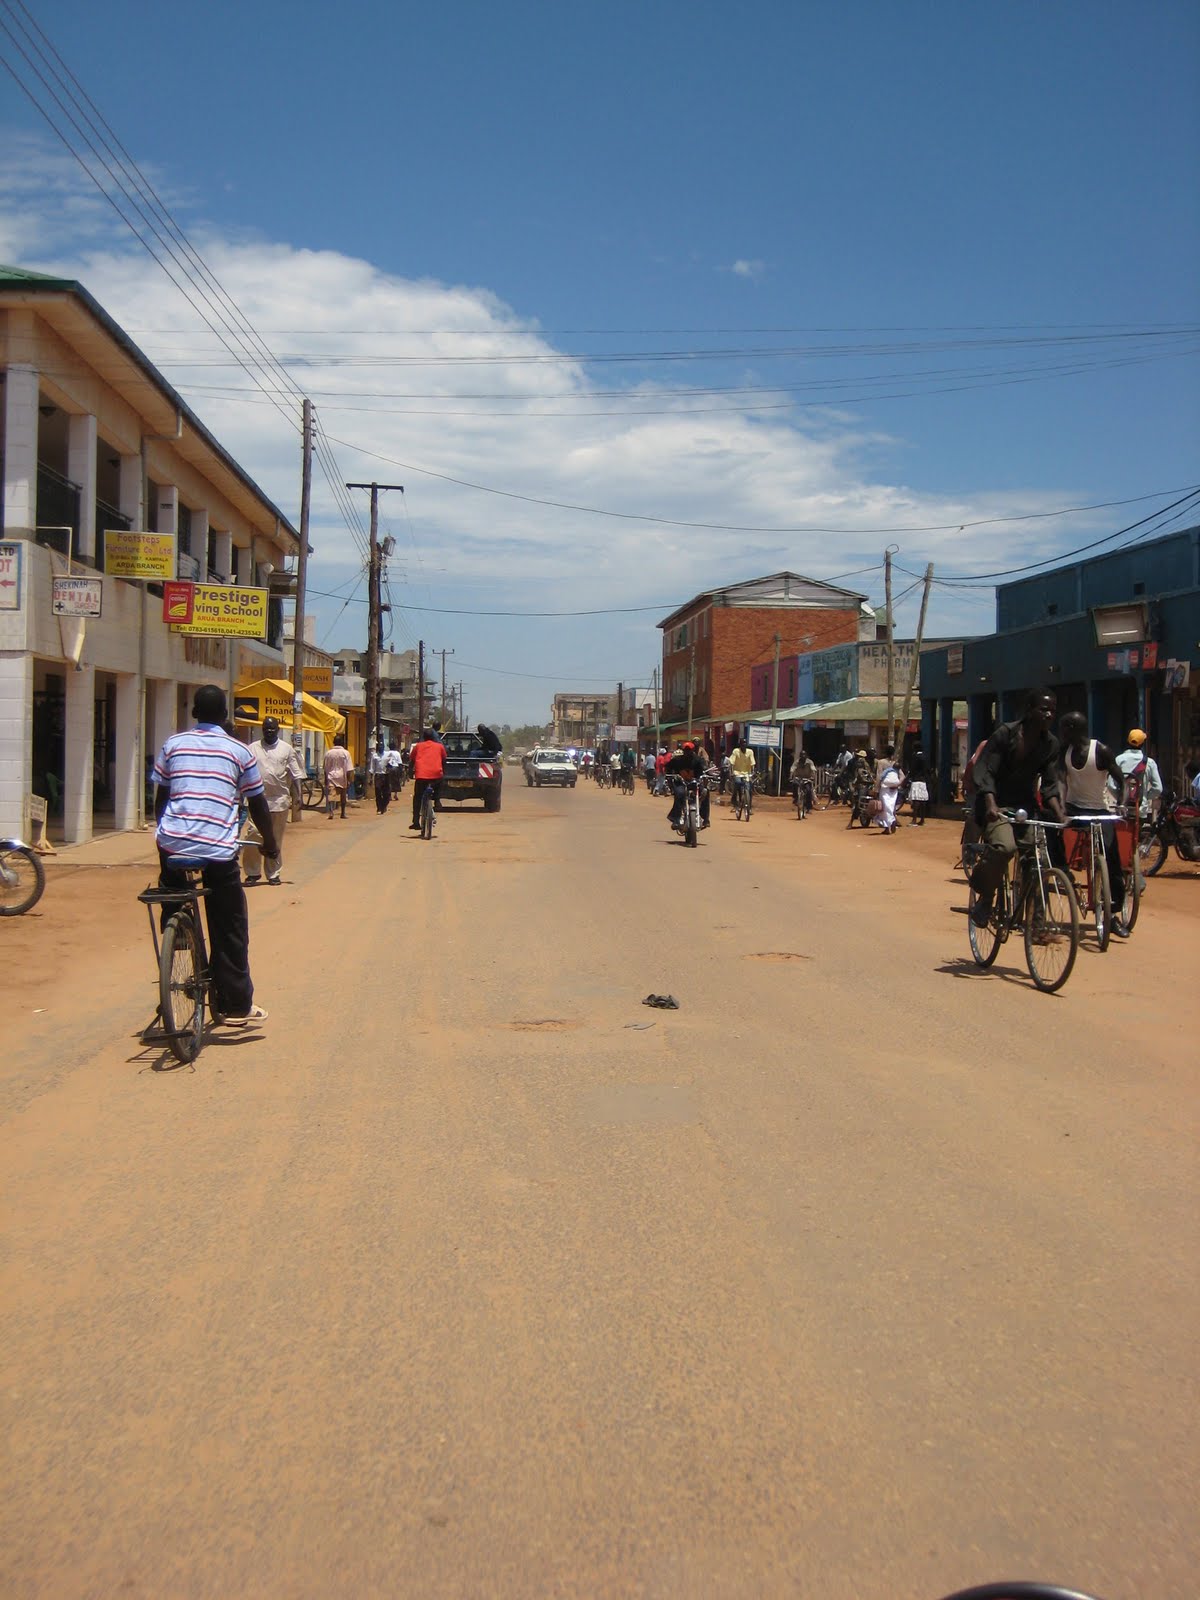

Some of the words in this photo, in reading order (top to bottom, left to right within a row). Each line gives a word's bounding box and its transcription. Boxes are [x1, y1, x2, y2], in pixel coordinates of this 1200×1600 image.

[54, 590, 99, 603] DENTAL
[194, 587, 260, 606] Prestige
[194, 602, 220, 616] ving
[224, 604, 263, 617] School
[863, 645, 914, 657] HEATH
[265, 697, 294, 706] Housi
[265, 706, 294, 715] Financ
